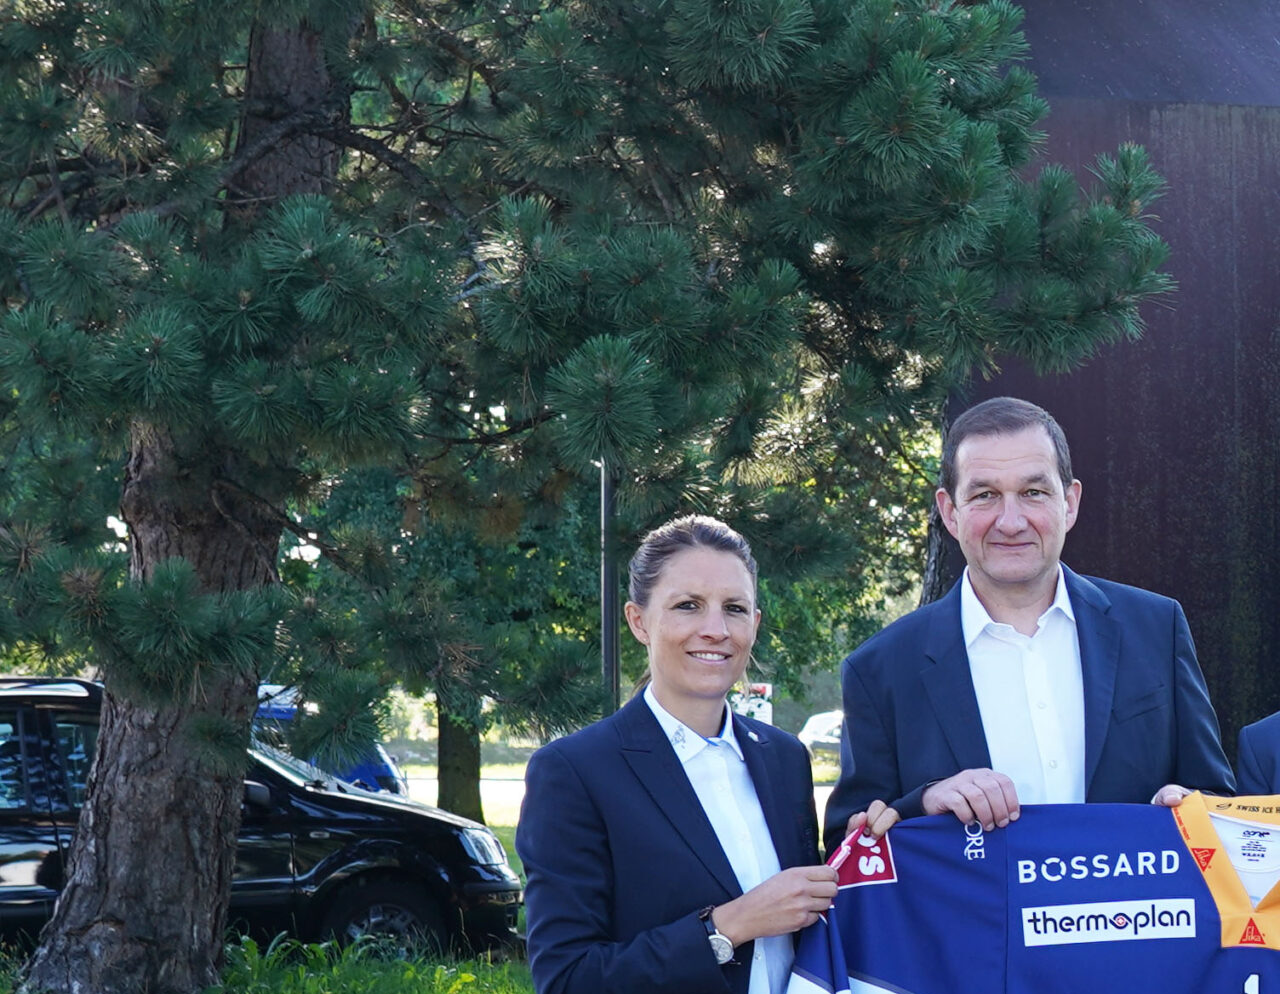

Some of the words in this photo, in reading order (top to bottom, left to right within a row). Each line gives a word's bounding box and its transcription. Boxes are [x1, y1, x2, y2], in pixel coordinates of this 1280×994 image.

[1236, 804, 1260, 813] SWISS
[1262, 806, 1274, 814] ICE
[1017, 849, 1180, 884] BOSSARD
[1027, 903, 1192, 935] thermoplan
